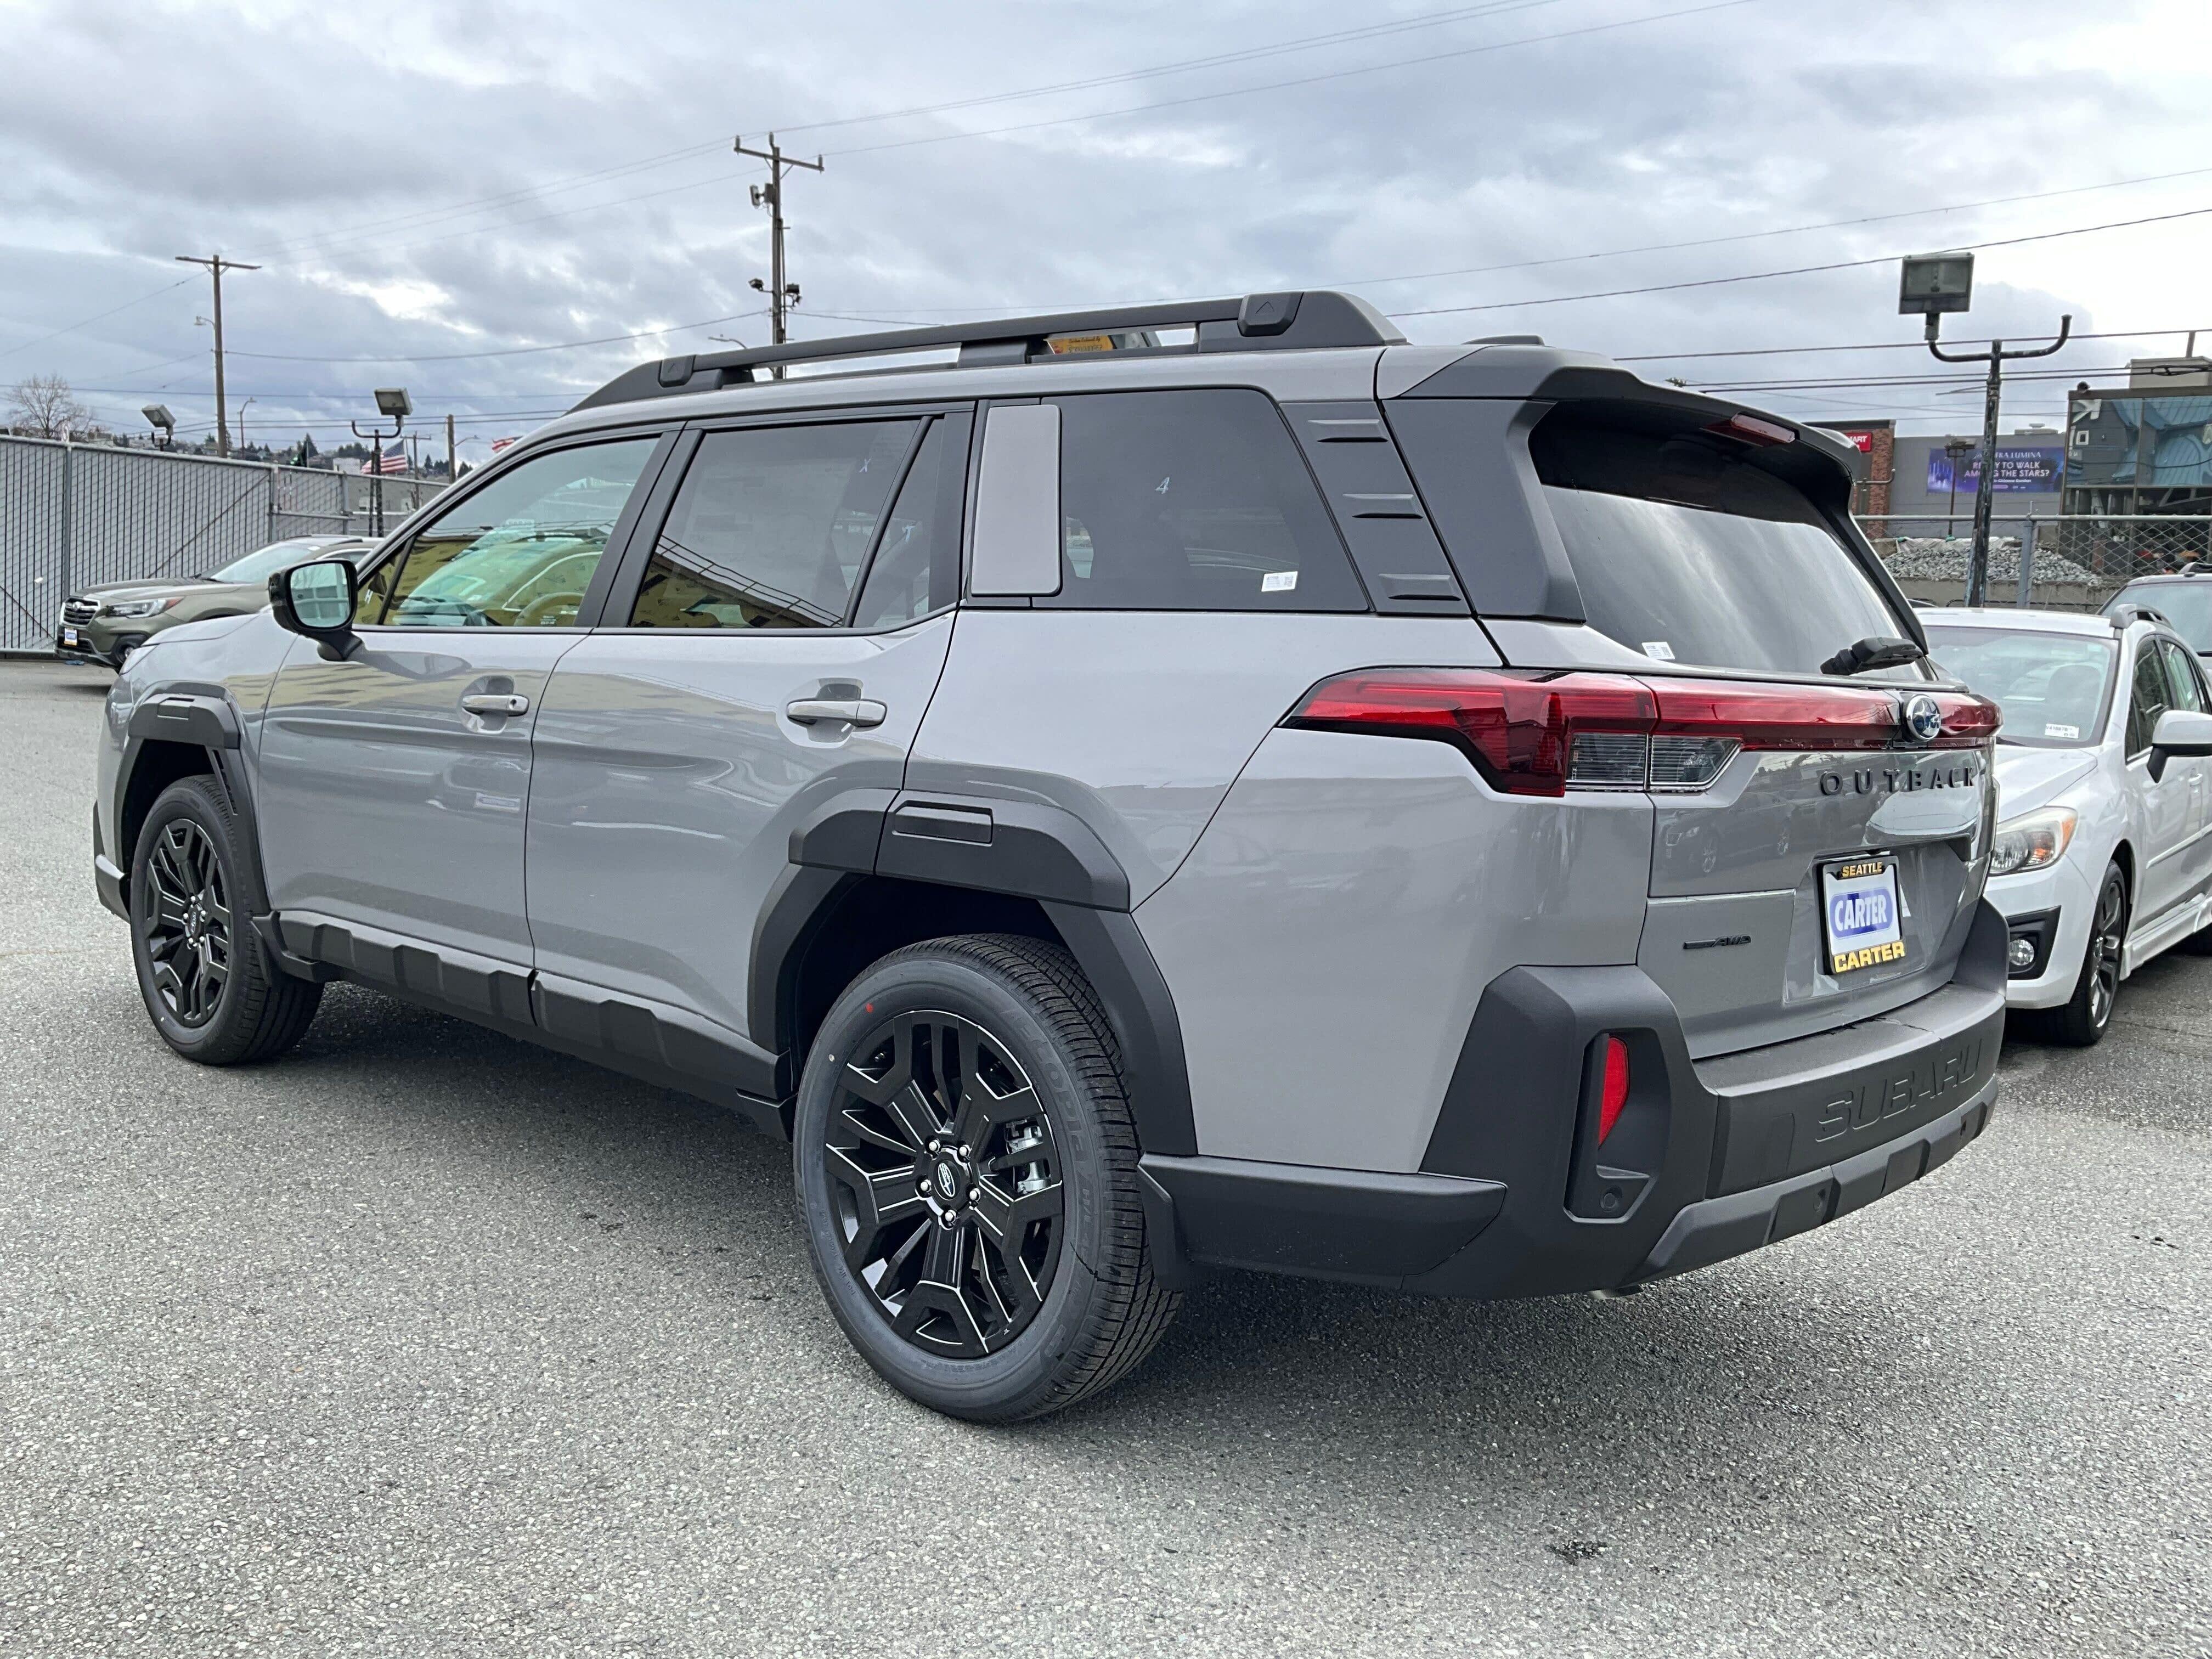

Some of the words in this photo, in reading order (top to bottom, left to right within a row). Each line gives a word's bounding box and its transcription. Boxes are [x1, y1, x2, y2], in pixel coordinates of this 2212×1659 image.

[1820, 766, 1975, 795] OUTBACK
[1841, 861, 1883, 878] SEATTLE
[1834, 894, 1888, 932] CARTER
[1833, 941, 1906, 973] CARTER
[1815, 1039, 1983, 1143] SUBARU
